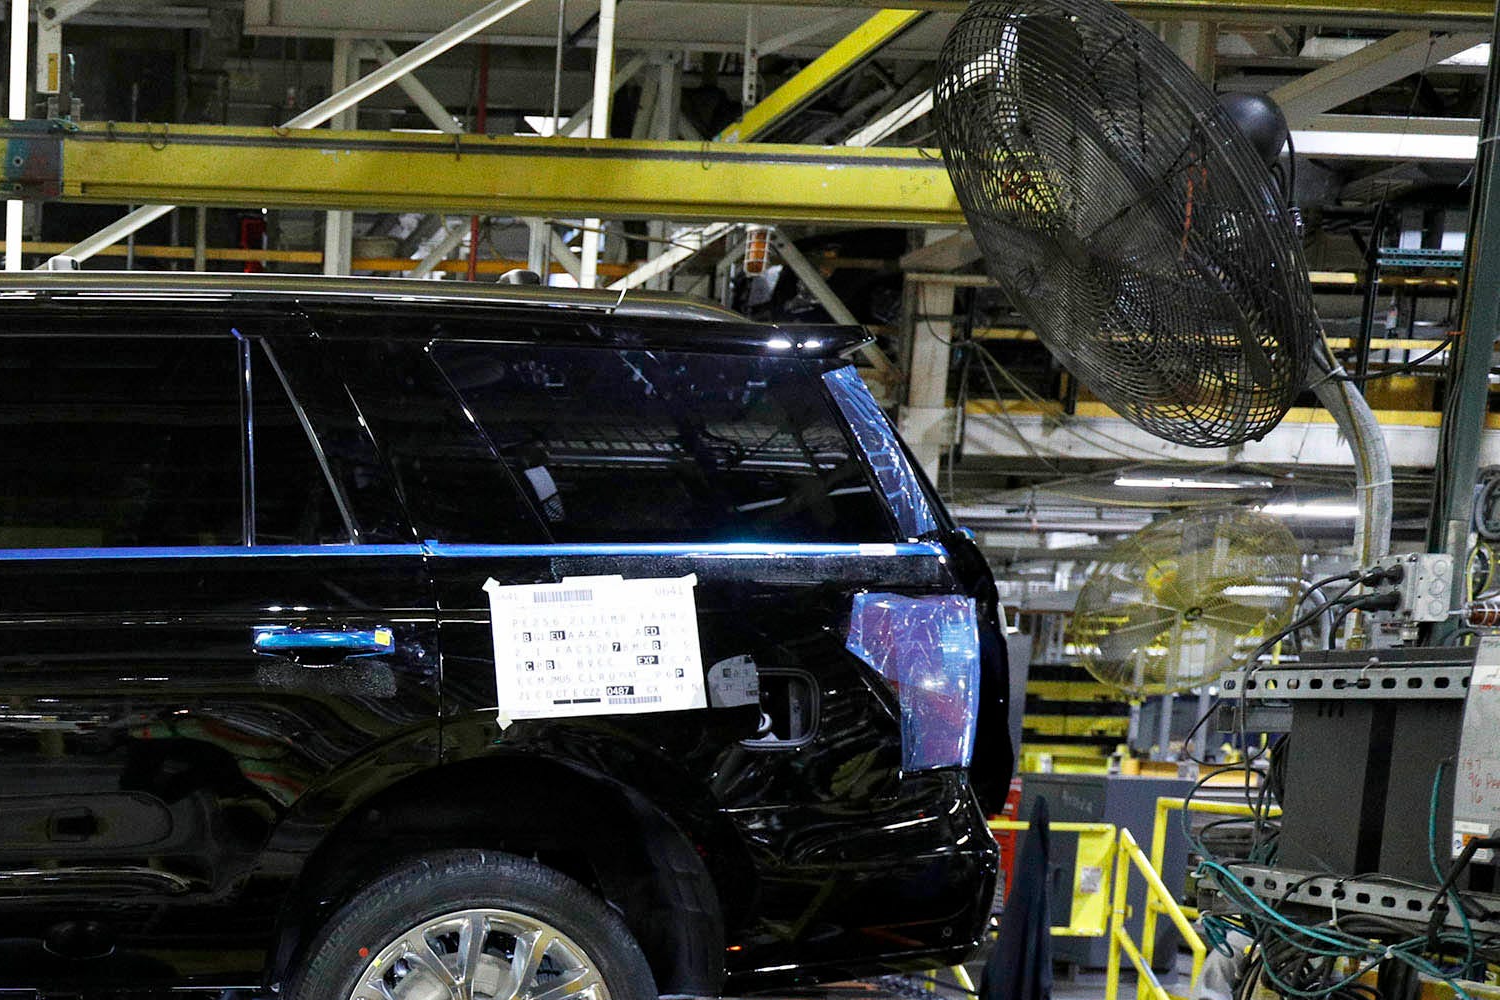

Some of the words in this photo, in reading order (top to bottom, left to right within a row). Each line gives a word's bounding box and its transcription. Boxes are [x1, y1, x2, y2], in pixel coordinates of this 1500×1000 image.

[550, 631, 564, 640] EU
[644, 626, 658, 636] ED
[636, 656, 656, 666] EXP
[606, 687, 630, 696] 0487
